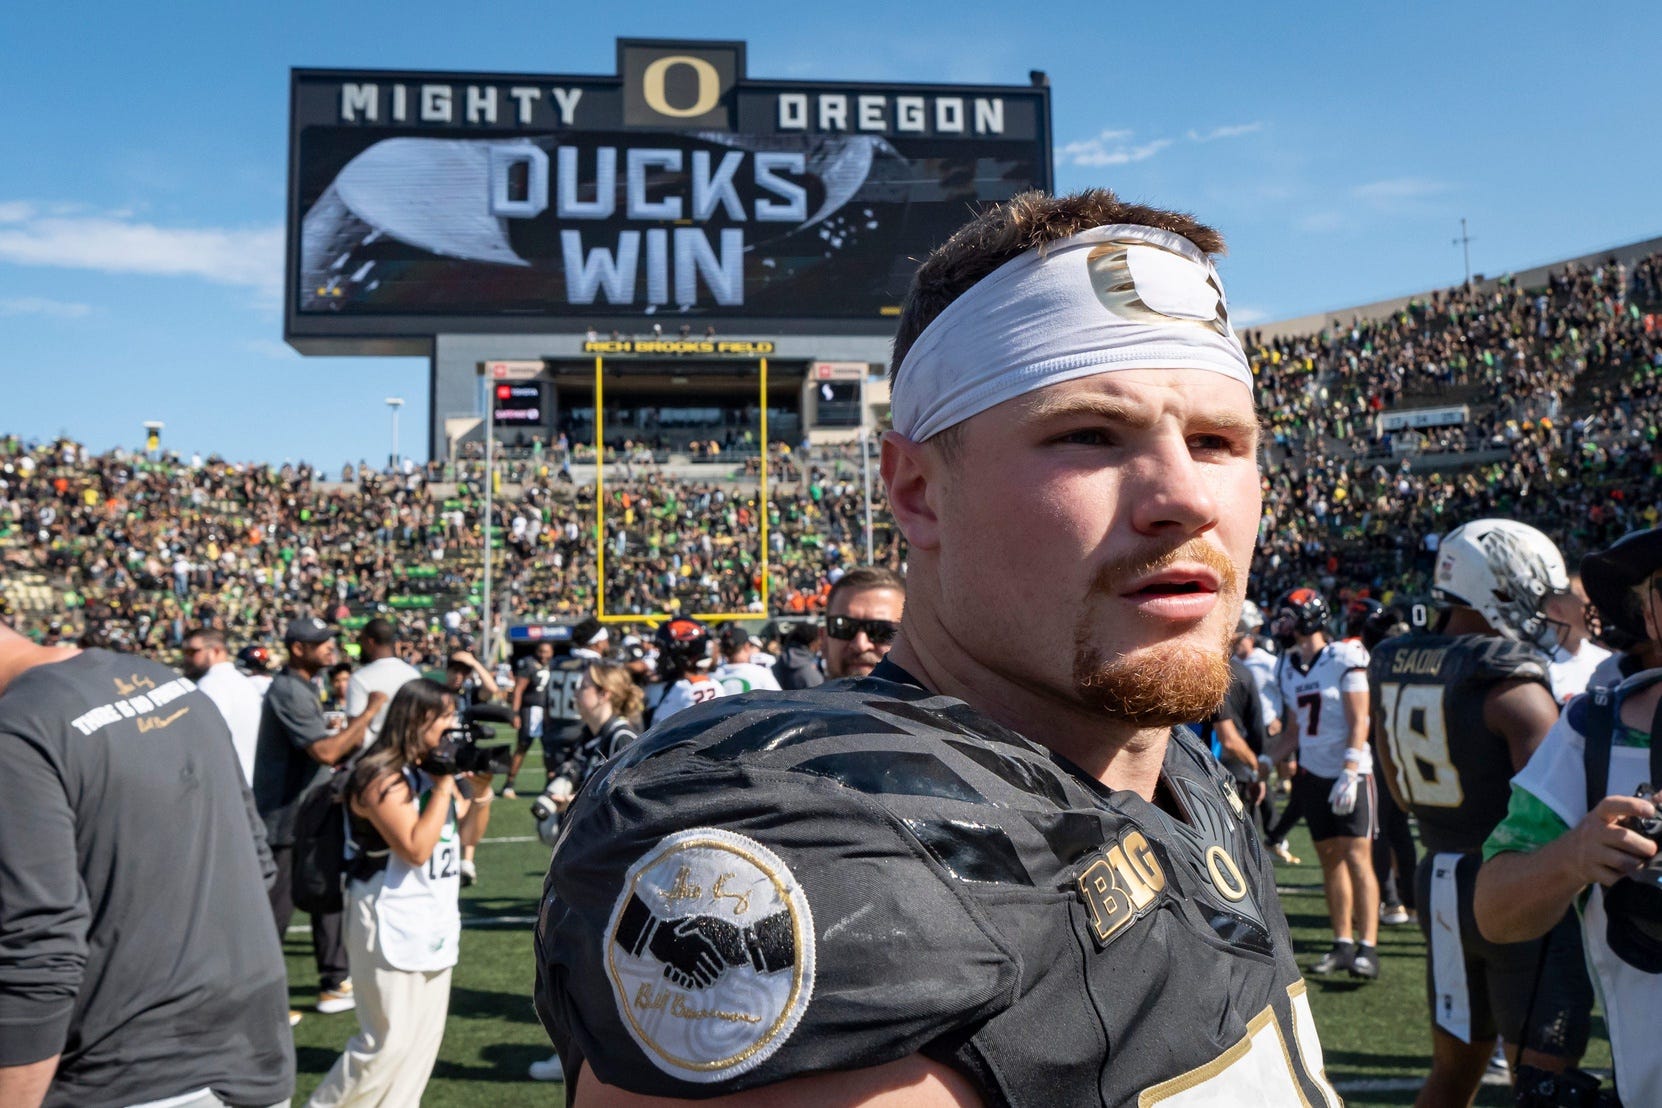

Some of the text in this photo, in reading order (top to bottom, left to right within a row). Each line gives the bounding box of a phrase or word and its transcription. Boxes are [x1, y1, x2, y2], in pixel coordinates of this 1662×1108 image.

[341, 83, 1004, 134] MIGHTY OREGON
[643, 56, 720, 117] O
[491, 145, 807, 222] DUCKS
[561, 228, 744, 306] WIN
[585, 341, 773, 353] RICH BROOKS FIELD
[536, 669, 550, 692] 7
[1296, 691, 1322, 736] 7
[1379, 682, 1464, 807] 18
